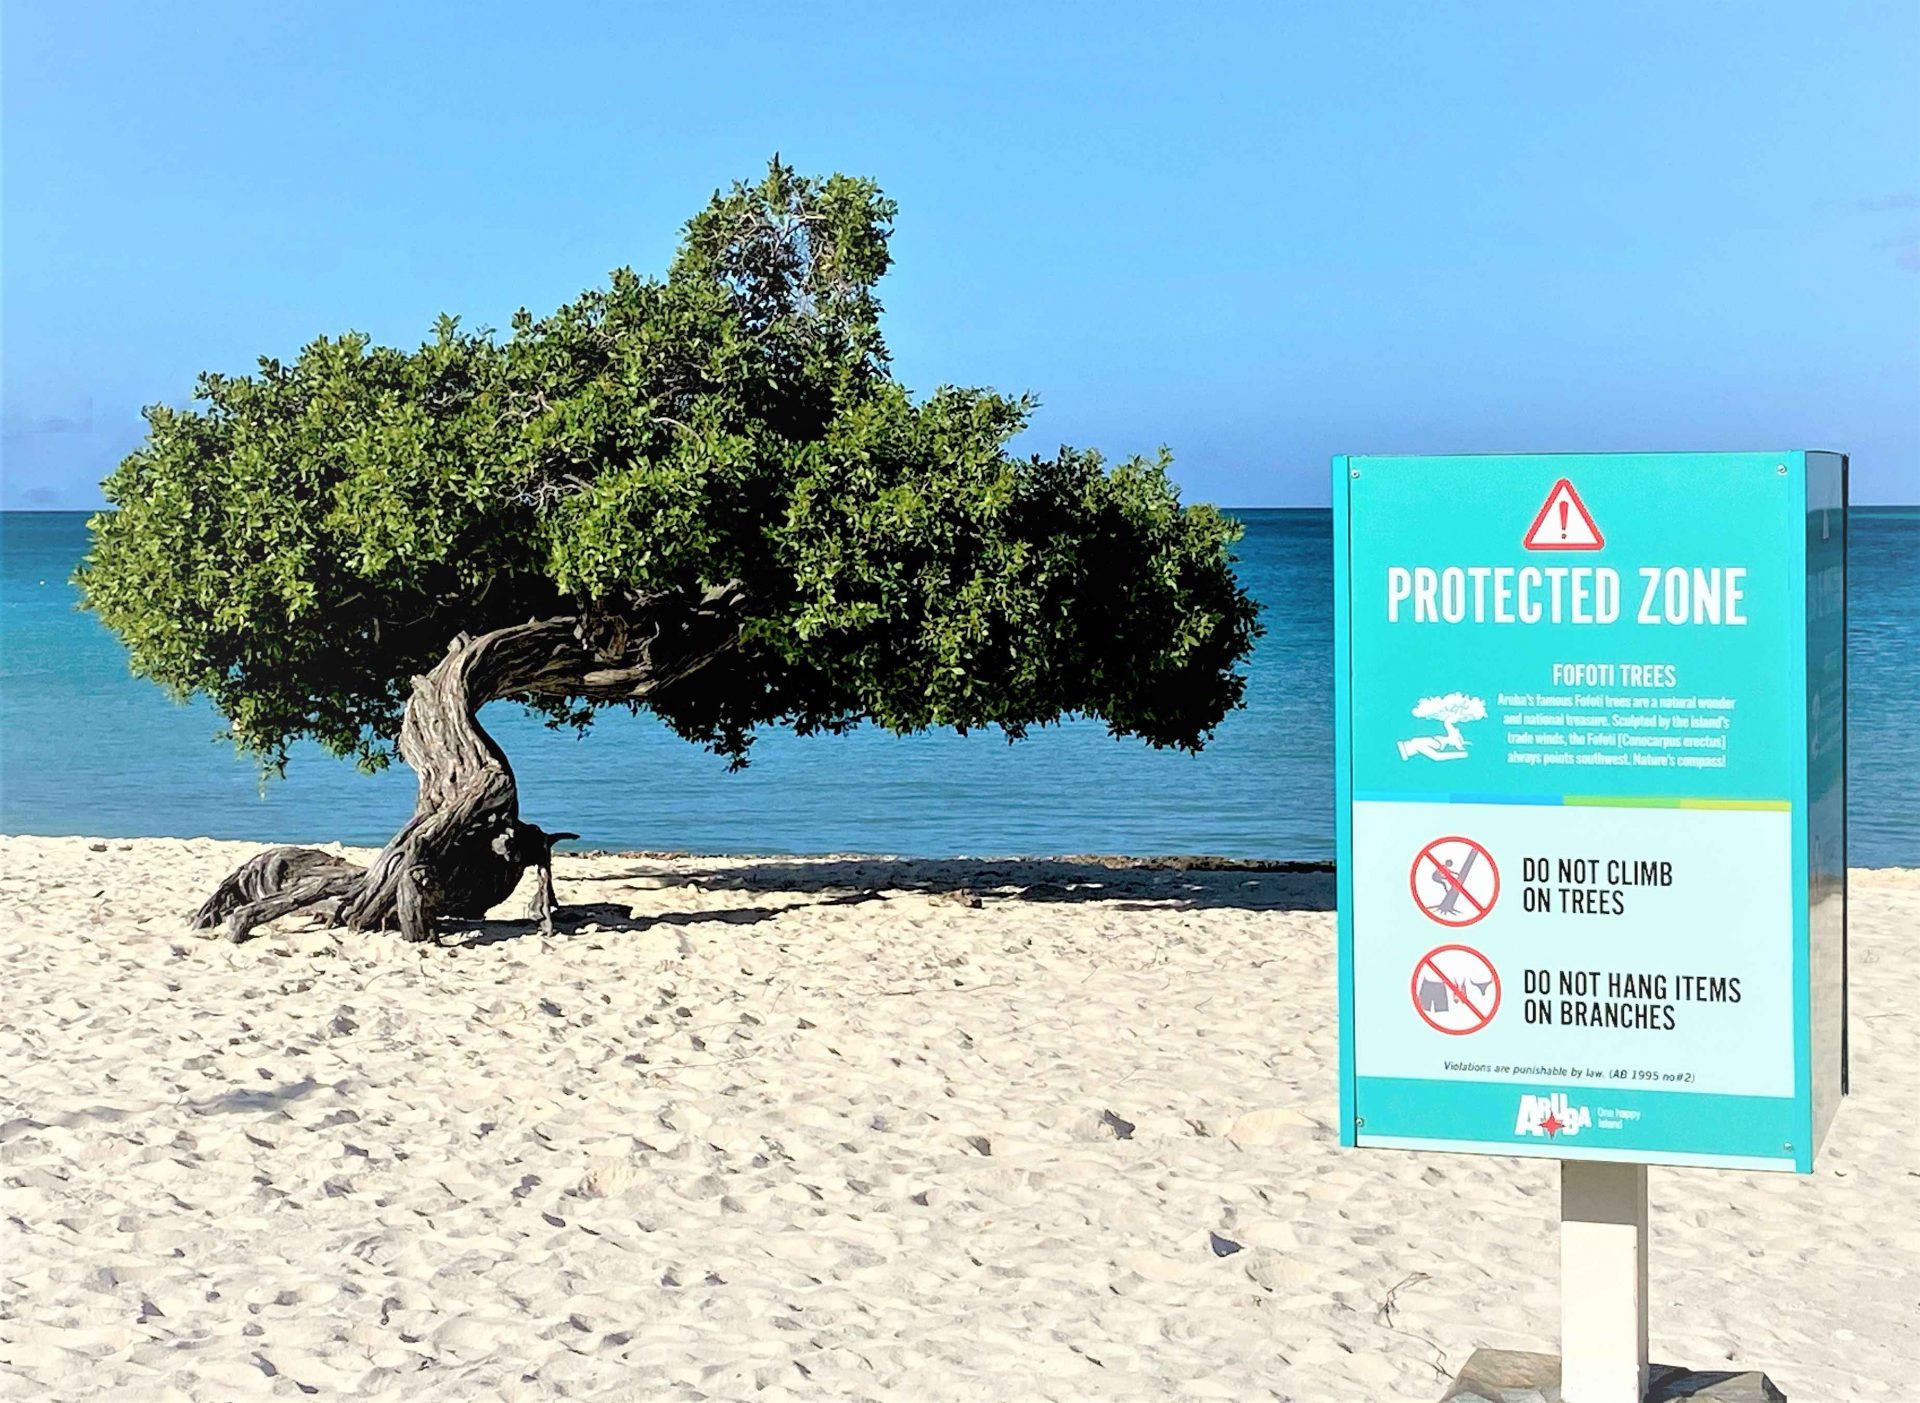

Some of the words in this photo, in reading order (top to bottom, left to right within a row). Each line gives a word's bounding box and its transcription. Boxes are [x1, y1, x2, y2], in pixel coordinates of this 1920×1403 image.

[1387, 566, 1620, 625] PROTECTED
[1637, 566, 1748, 626] ZONE
[1552, 663, 1615, 687] FOFOTI
[1620, 664, 1678, 688] TREES
[1497, 692, 1535, 706] Aruba's
[1536, 693, 1574, 707] famous
[1574, 694, 1604, 708] Fofoti
[1605, 695, 1632, 708] trees
[1632, 697, 1650, 708] are
[1650, 698, 1658, 708] a
[1659, 695, 1697, 709] natural
[1697, 696, 1737, 710] wonder
[1503, 712, 1523, 725] and
[1523, 712, 1565, 726] national
[1565, 713, 1611, 728] treasure.
[1611, 713, 1657, 730] Sculpted
[1658, 715, 1672, 731] by
[1672, 715, 1690, 728] the
[1690, 715, 1731, 729] island's
[1507, 732, 1534, 745] trade
[1534, 732, 1568, 747] winds,
[1568, 732, 1586, 746] the
[1586, 733, 1617, 746] Fofoti
[1507, 751, 1542, 766] always
[1542, 751, 1575, 767] points
[1575, 752, 1632, 766] southwest.
[1632, 753, 1676, 767] Nature's
[1523, 857, 1550, 883] DO
[1558, 858, 1600, 885] NOT
[1607, 860, 1673, 887] CLIMB
[1523, 887, 1551, 912] ON
[1558, 888, 1625, 916] TREES
[1524, 969, 1551, 995] DO
[1559, 970, 1601, 997] NOT
[1608, 972, 1667, 1000] HANG
[1675, 975, 1742, 1003] ITEMS
[1524, 999, 1552, 1025] ON
[1560, 1001, 1676, 1031] BRANCHES
[1444, 1060, 1492, 1073] Violations
[1493, 1064, 1511, 1074] are
[1512, 1064, 1569, 1077] punishable
[1570, 1066, 1584, 1079] by
[1585, 1067, 1605, 1079] law.
[1608, 1068, 1629, 1080] (AB
[1631, 1070, 1660, 1081] 1995
[1513, 1091, 1593, 1138] ARUBA
